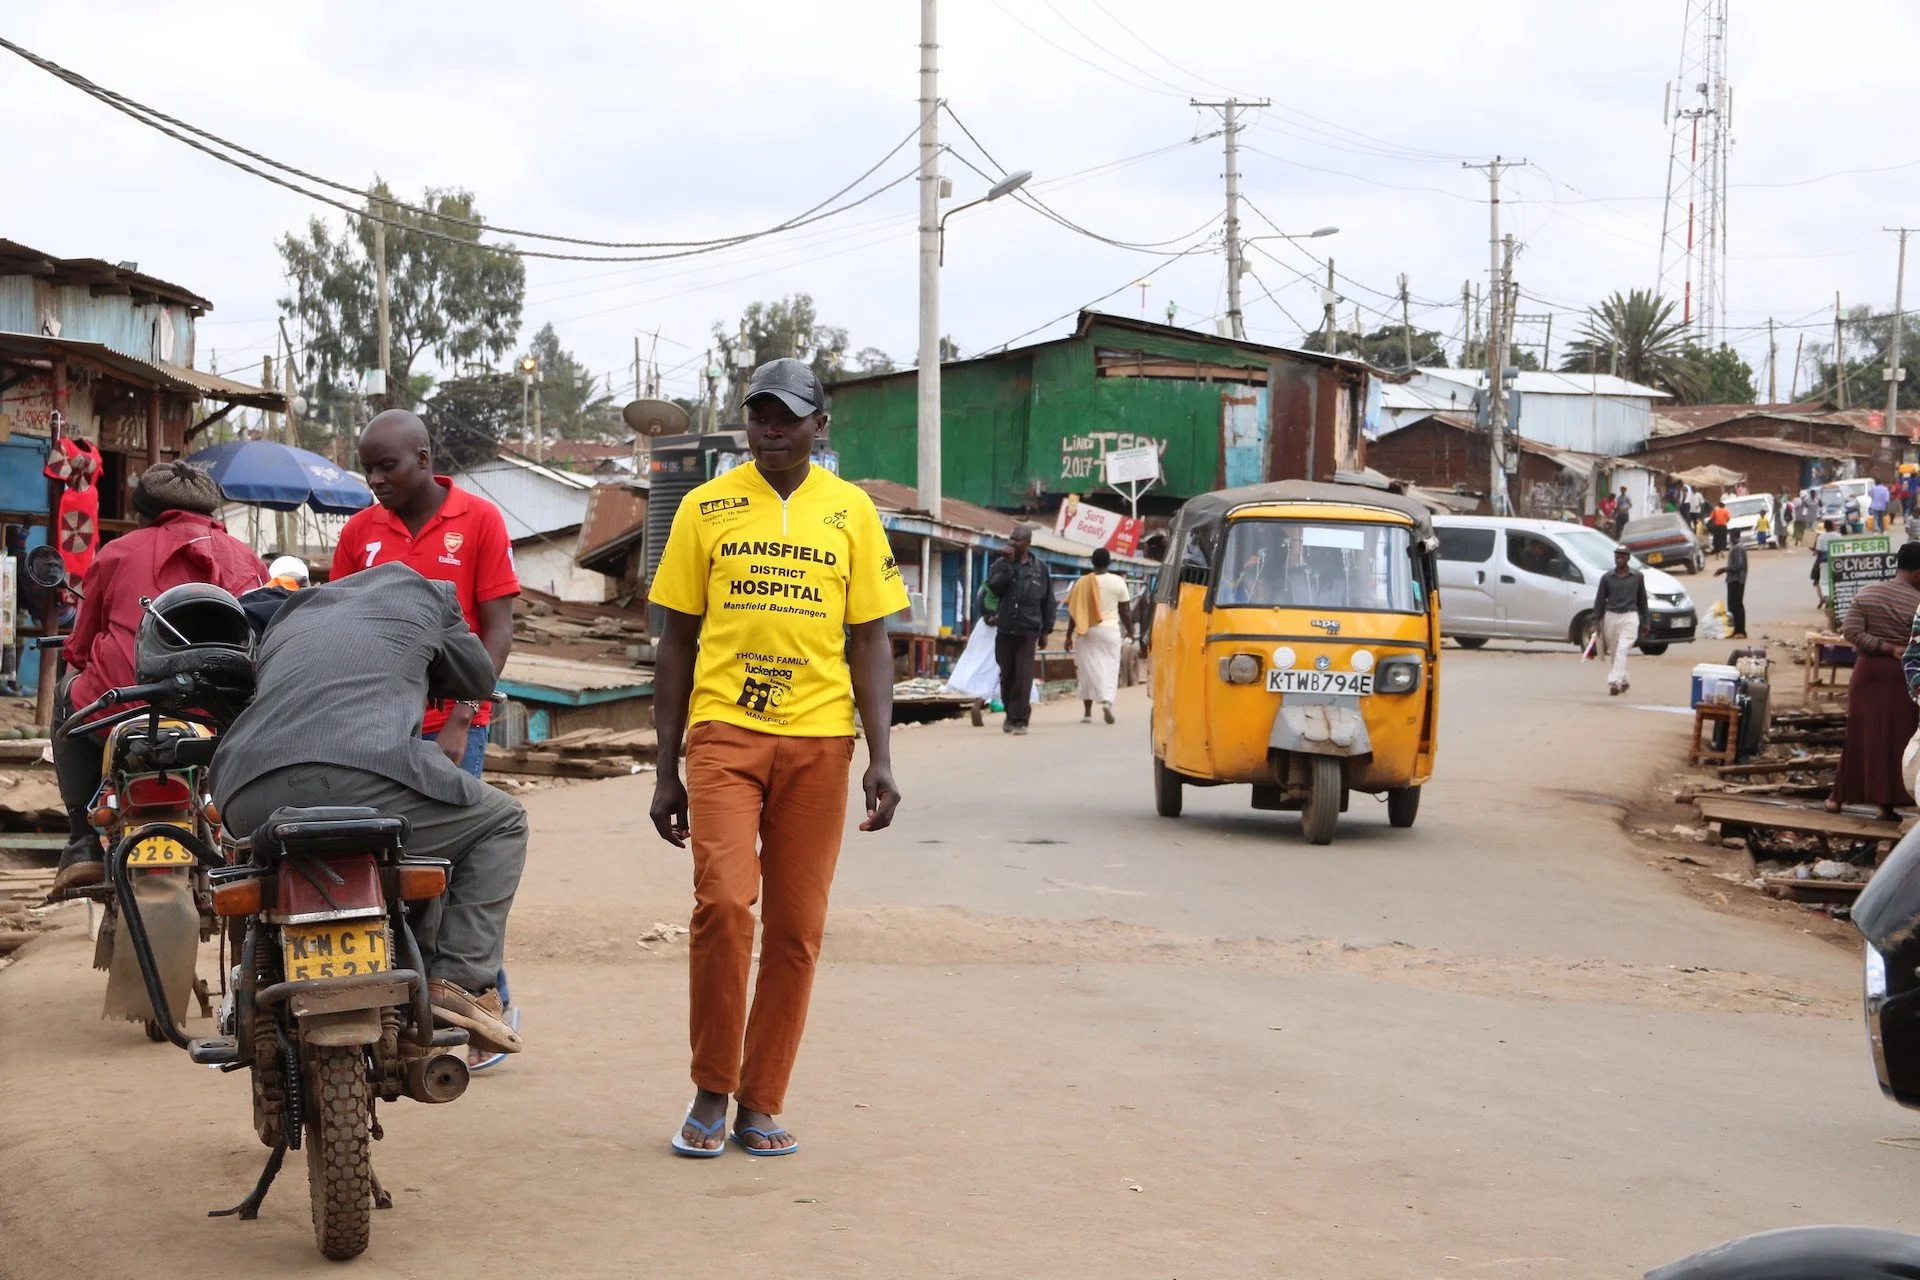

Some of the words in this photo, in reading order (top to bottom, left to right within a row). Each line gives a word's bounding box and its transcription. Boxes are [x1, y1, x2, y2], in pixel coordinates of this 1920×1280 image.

[1060, 456, 1093, 479] 2017
[1077, 520, 1106, 539] Beauty
[365, 541, 382, 567] 7
[720, 541, 837, 566] MANSFIELD
[750, 565, 806, 579] DISTRICT
[730, 580, 823, 603] HOSPITAL
[723, 601, 767, 611] Mansfield
[769, 603, 827, 619] Bushrangers
[735, 652, 774, 663] THOMAS
[776, 656, 810, 666] FAMILY
[744, 662, 793, 680] Tuckerbag
[745, 711, 789, 726] MANSFIELD
